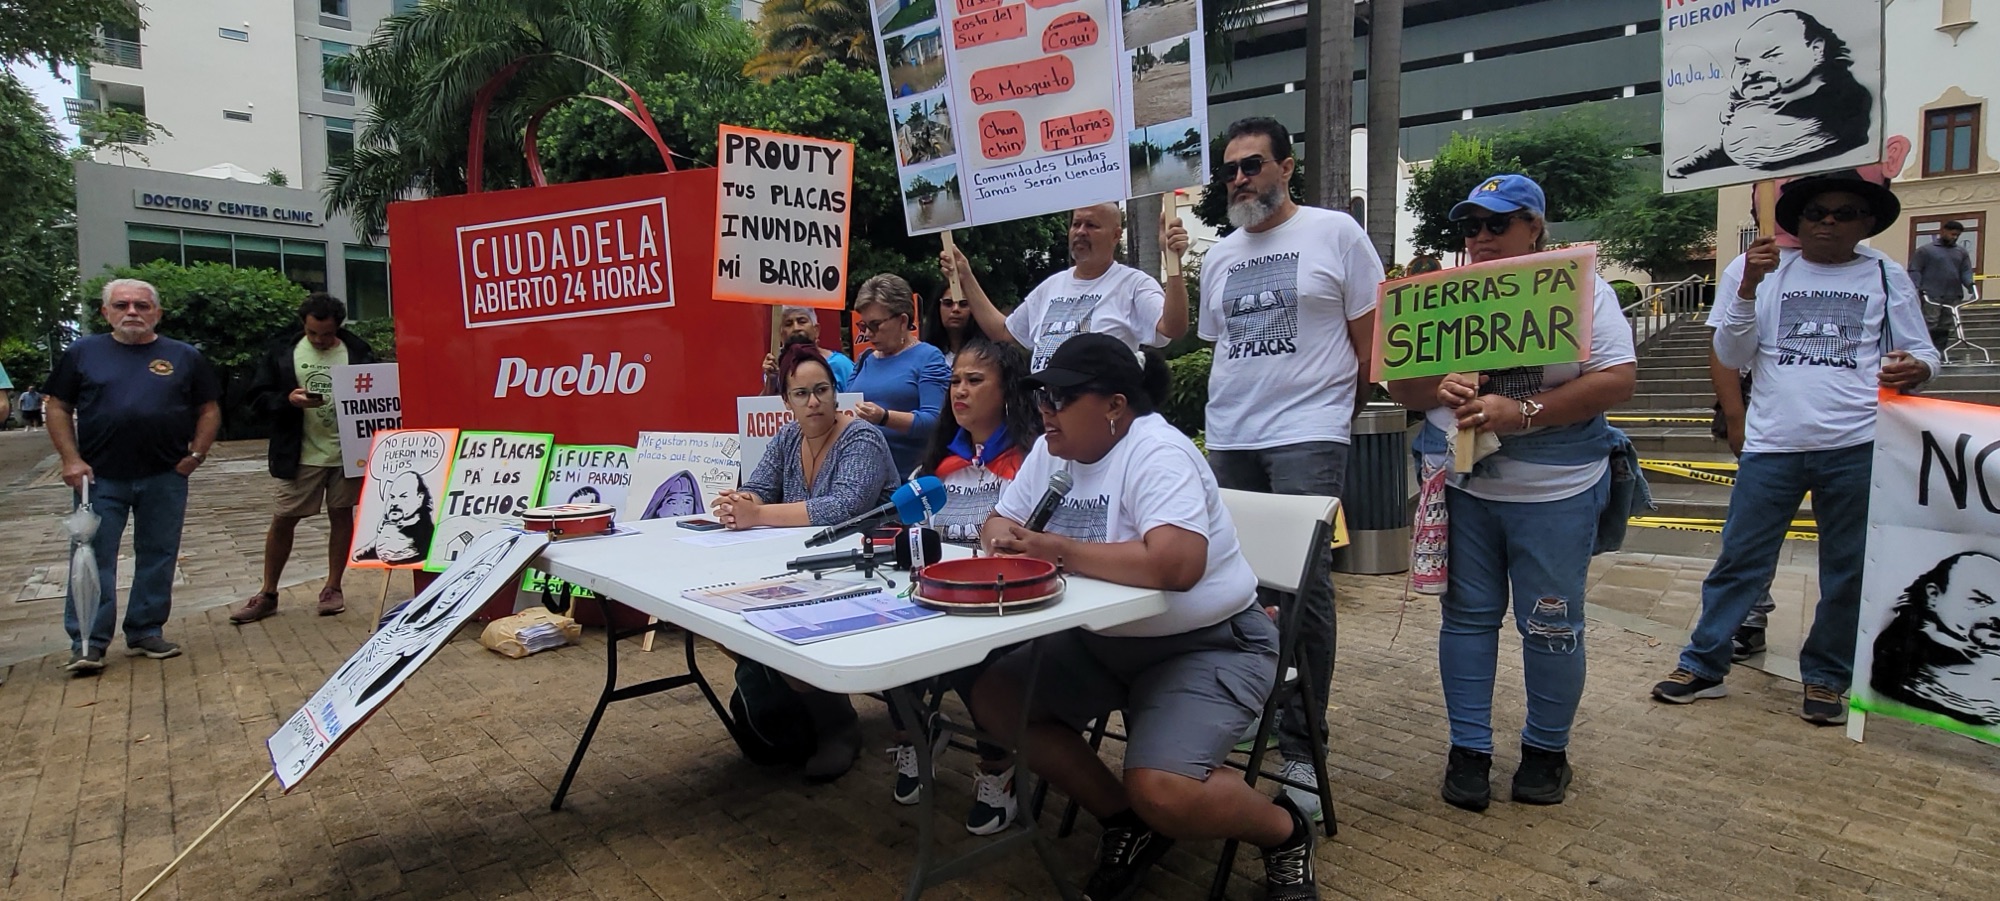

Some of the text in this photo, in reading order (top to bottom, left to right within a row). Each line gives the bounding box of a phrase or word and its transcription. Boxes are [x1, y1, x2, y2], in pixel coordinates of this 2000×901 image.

[954, 8, 1013, 33] Costa del
[1668, 0, 1736, 31] FUERON
[958, 32, 984, 44] Sur
[998, 66, 1070, 97] Mosquito
[983, 120, 1018, 139] Chun
[1040, 116, 1111, 140] Trinitarias
[725, 133, 843, 175] PROUTY
[973, 150, 1107, 186] Comunidades Unidas
[1024, 173, 1062, 191] Serán
[722, 181, 847, 213] TUS PLACAS
[218, 202, 268, 219] CENTER
[272, 208, 313, 222] CLINIC
[720, 214, 842, 249] INUNDAN
[471, 214, 659, 279] CIUDADELA
[1227, 251, 1300, 275] NOS INUNDAN
[473, 261, 664, 315] ABIERTO 24 HORAS
[1781, 290, 1870, 302] NOS INUNDAN
[1383, 305, 1581, 368] SEMBRAR
[1228, 338, 1297, 360] DE PLACAS
[385, 436, 437, 449] NO FUI YO
[420, 449, 439, 459] MIS
[458, 437, 546, 460] LAS PLACAS
[637, 449, 667, 463] placas
[492, 470, 521, 484] LOS
[548, 469, 562, 482] DE
[448, 490, 530, 517] TECHOS
